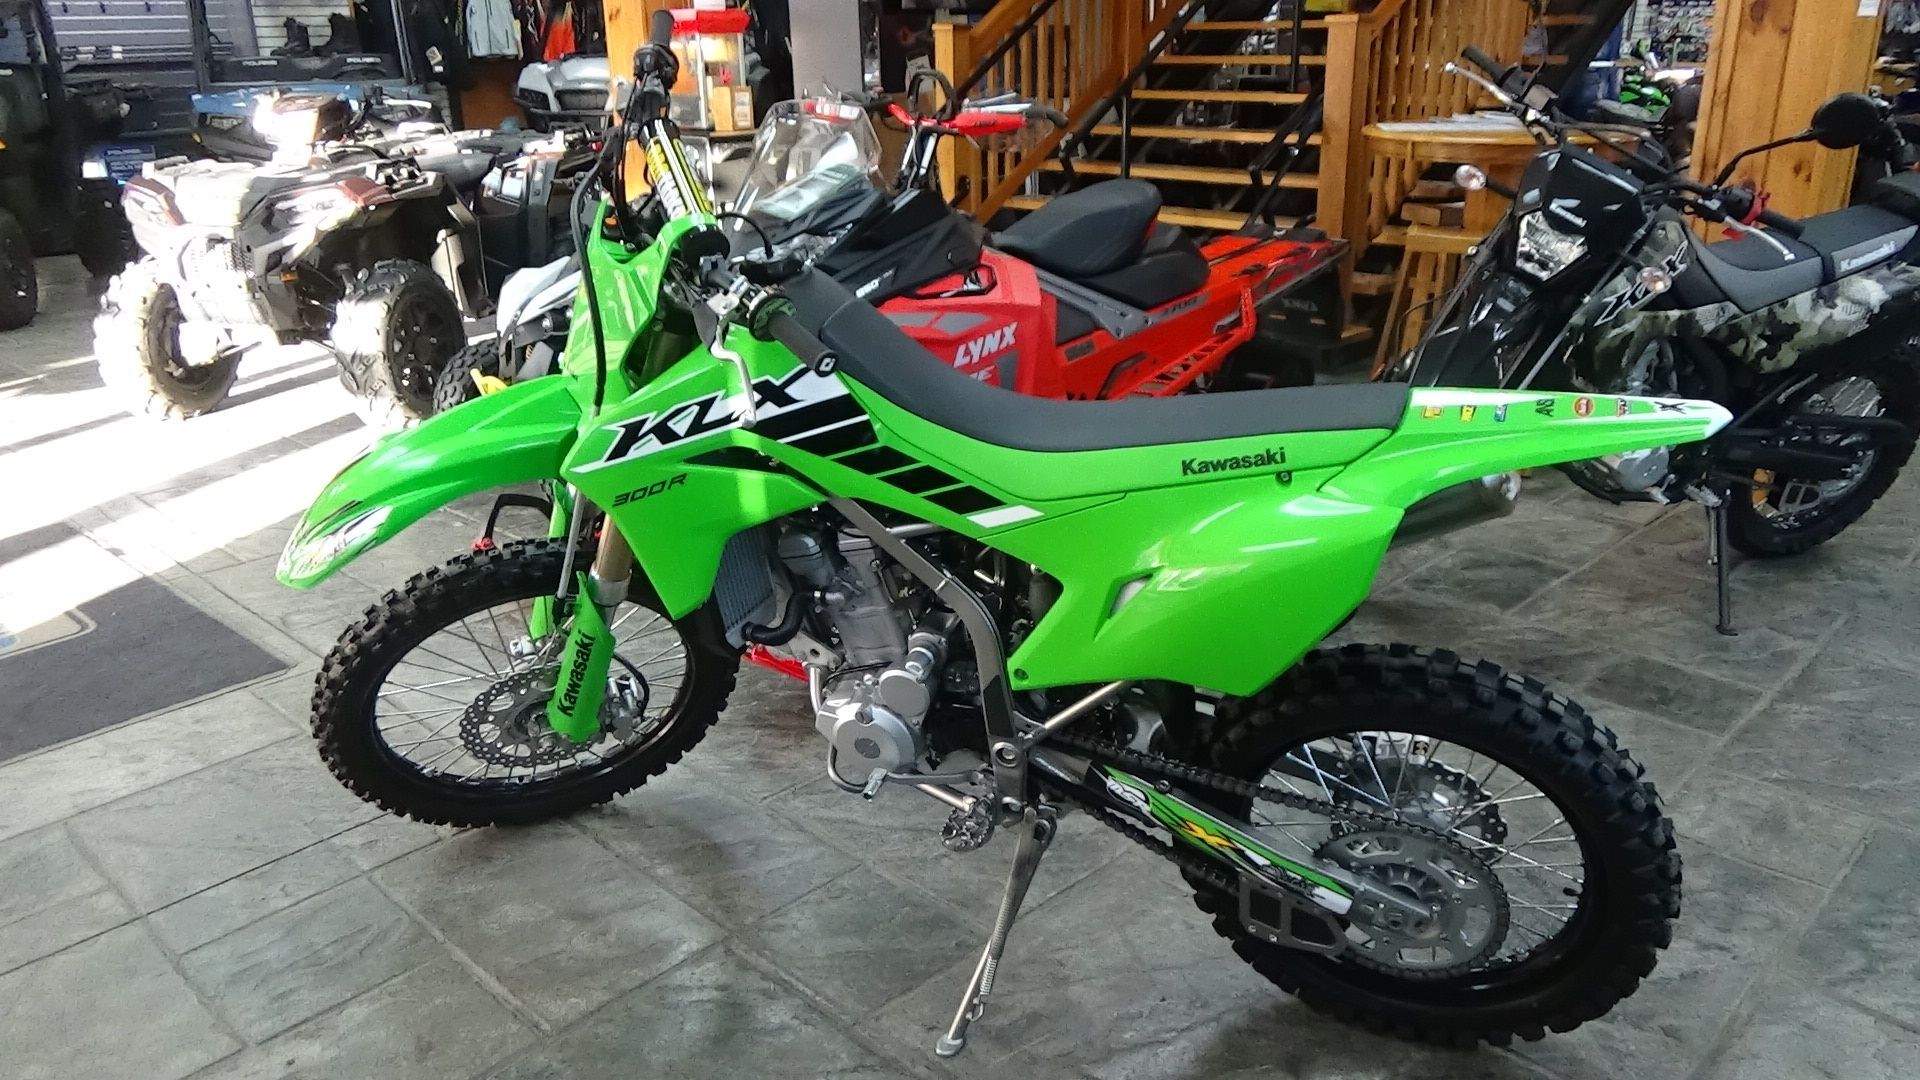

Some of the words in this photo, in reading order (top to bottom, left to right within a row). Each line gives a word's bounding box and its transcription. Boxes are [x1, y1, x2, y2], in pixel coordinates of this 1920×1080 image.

[953, 321, 1018, 368] LYNX
[604, 366, 808, 463] KLX
[1182, 447, 1286, 476] Kawasaki
[612, 472, 687, 507] 300R
[557, 628, 596, 717] Kawasaki
